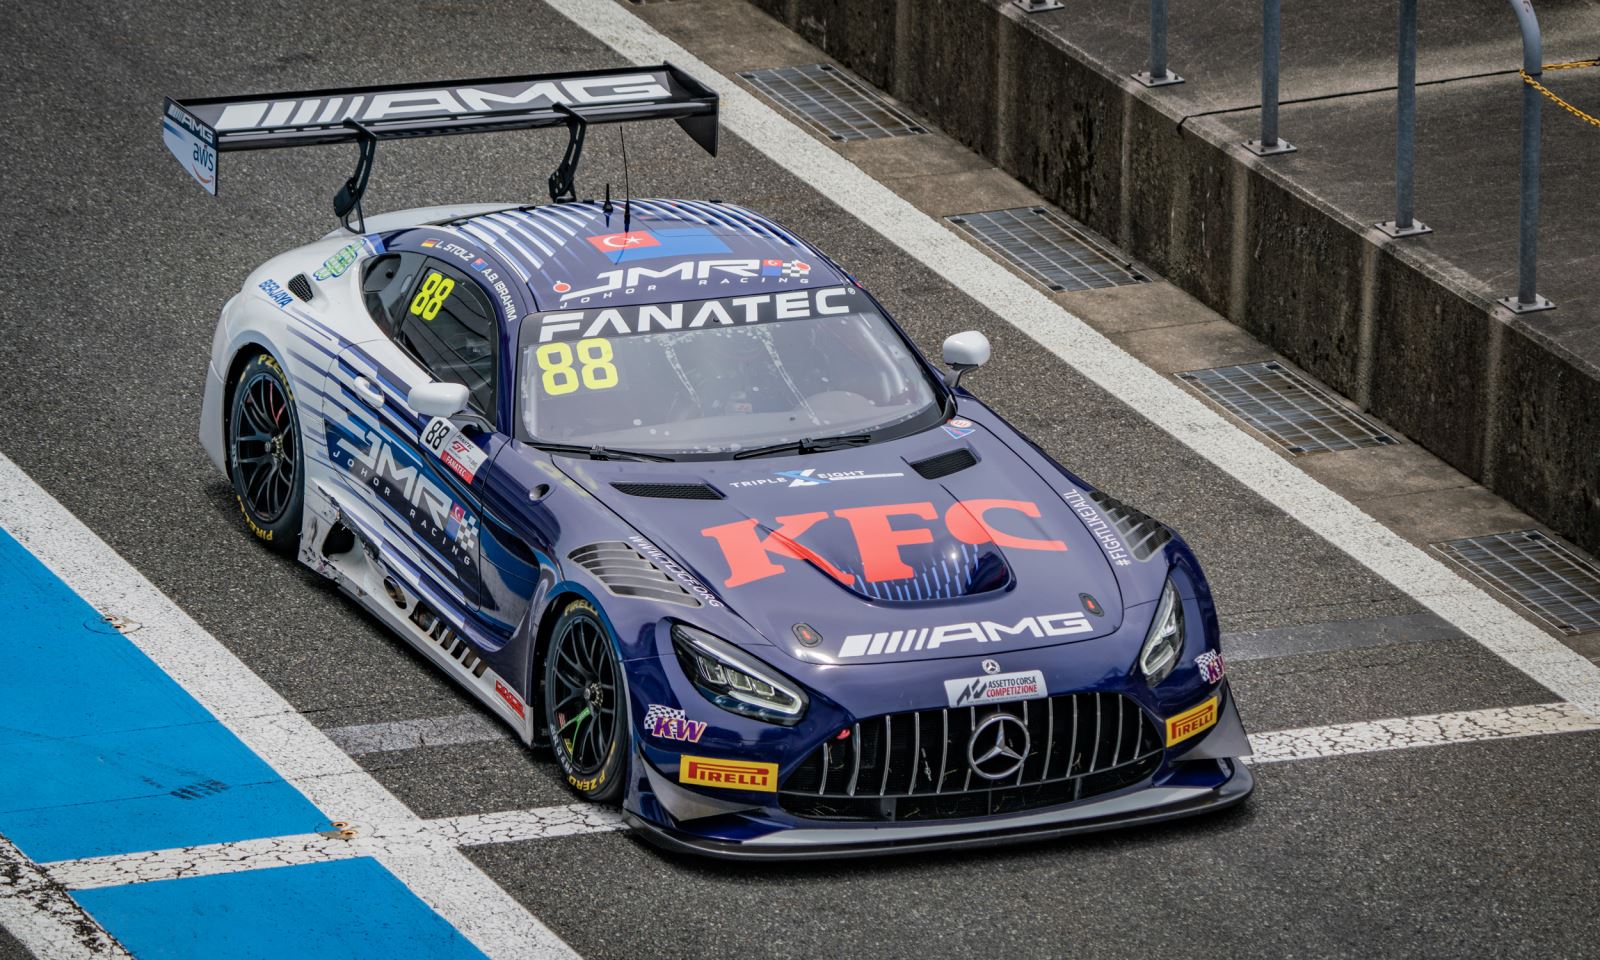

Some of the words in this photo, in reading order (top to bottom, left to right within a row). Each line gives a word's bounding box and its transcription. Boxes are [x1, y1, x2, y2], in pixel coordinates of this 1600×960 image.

[363, 74, 672, 121] AMG
[193, 141, 214, 172] aws
[443, 243, 476, 262] STOLZ
[258, 279, 294, 309] BERJAYA
[410, 272, 455, 321] 88
[559, 259, 760, 302] JMR
[560, 284, 656, 309] JOHOR
[698, 277, 810, 286] RACING
[493, 280, 518, 322] IBRAHIM
[536, 338, 619, 396] 88
[425, 420, 450, 450] 88
[336, 430, 453, 531] JMR
[729, 477, 788, 488] TRIPLE
[817, 470, 865, 479] EIGHT
[332, 450, 391, 496] JOHOR
[409, 510, 470, 566] RACING
[700, 498, 1068, 589] KFC
[986, 684, 1038, 698] COMPETIZIONE
[988, 678, 1015, 689] ASSETTO
[1015, 675, 1037, 687] CORSA
[653, 717, 707, 743] KW
[1171, 703, 1214, 740] PIRELLI
[688, 761, 770, 787] PIRELLI
